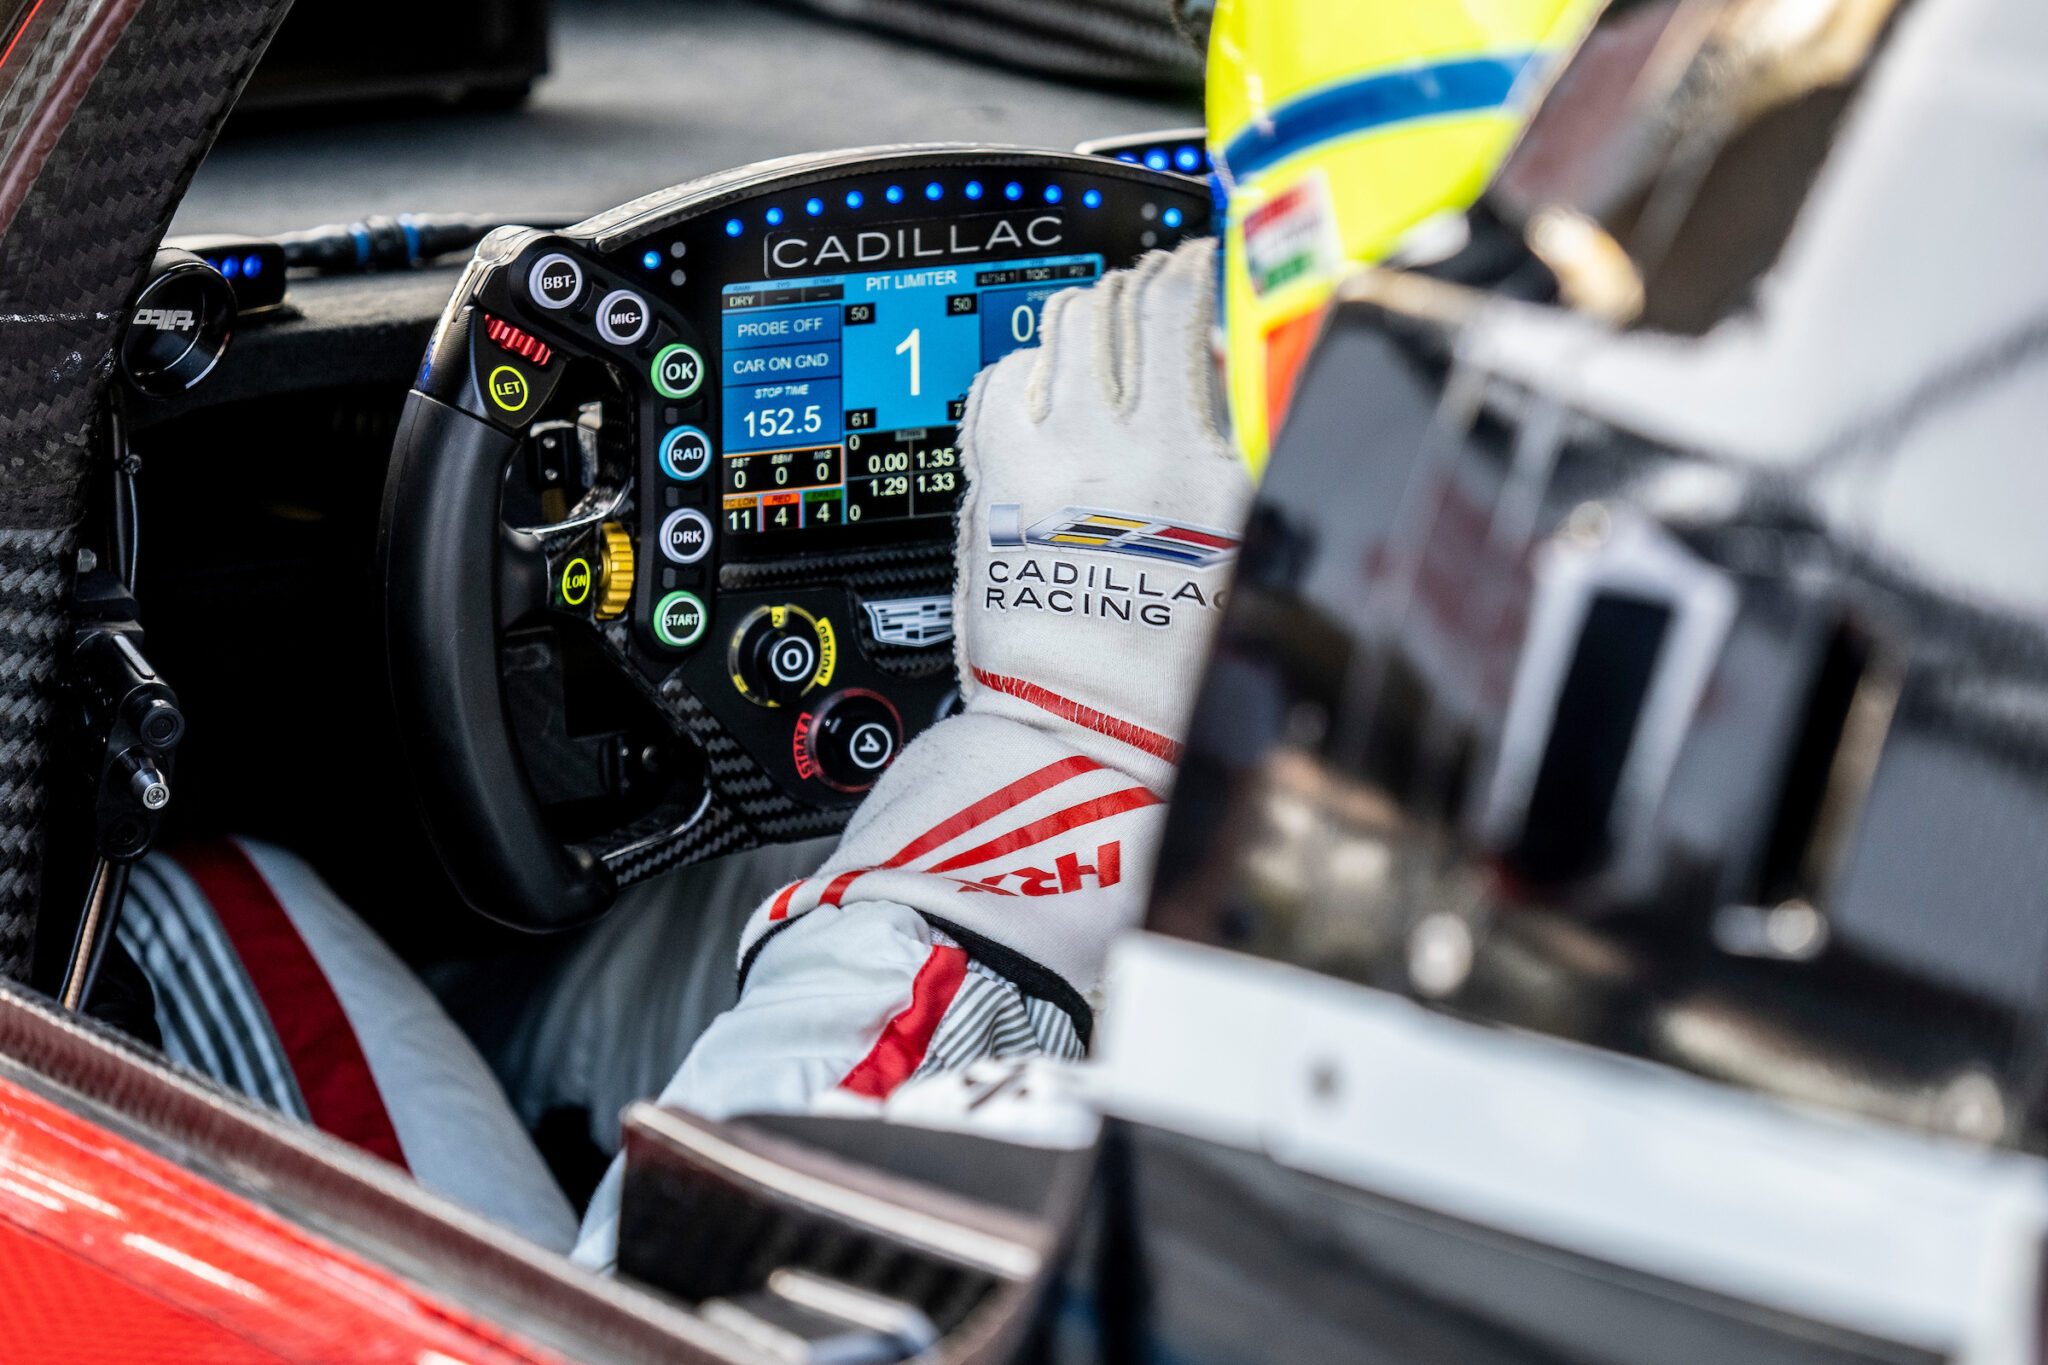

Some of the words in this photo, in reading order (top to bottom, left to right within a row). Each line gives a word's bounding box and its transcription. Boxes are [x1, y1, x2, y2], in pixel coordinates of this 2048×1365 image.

[772, 216, 1064, 269] CADILLAC
[543, 274, 575, 290] BBT-
[866, 276, 891, 291] PIT
[895, 271, 957, 289] LIMITER
[729, 295, 756, 307] DRY
[954, 298, 972, 311] 50
[610, 312, 641, 326] MIG-
[851, 308, 869, 321] 50
[737, 320, 789, 338] PROBE
[793, 317, 823, 333] OFF
[733, 358, 765, 374] CAR
[768, 357, 792, 371] ON
[795, 353, 829, 368] GND
[895, 328, 920, 396] 1
[665, 362, 695, 381] OK
[495, 381, 522, 396] LET
[754, 386, 783, 399] STOP
[785, 384, 809, 395] TIME
[744, 405, 822, 439] 152.5
[852, 412, 869, 427] 61
[849, 434, 861, 451] 0
[673, 446, 704, 462] RAD
[813, 450, 832, 460] MIG
[868, 453, 908, 474] 0.00
[916, 447, 955, 469] 1.35
[734, 471, 747, 488] 0
[775, 467, 788, 485] 0
[816, 462, 829, 481] 0
[869, 476, 908, 497] 1.29
[916, 472, 955, 493] 1.33
[728, 510, 750, 531] 11
[774, 506, 788, 526] 4
[816, 502, 831, 522] 4
[849, 504, 861, 521] 0
[673, 530, 702, 545] DRK
[566, 573, 586, 589] LON
[985, 586, 1171, 626] RACING
[665, 612, 700, 627] START
[774, 614, 781, 625] 2
[818, 626, 831, 679] OPTION
[859, 732, 881, 752] A
